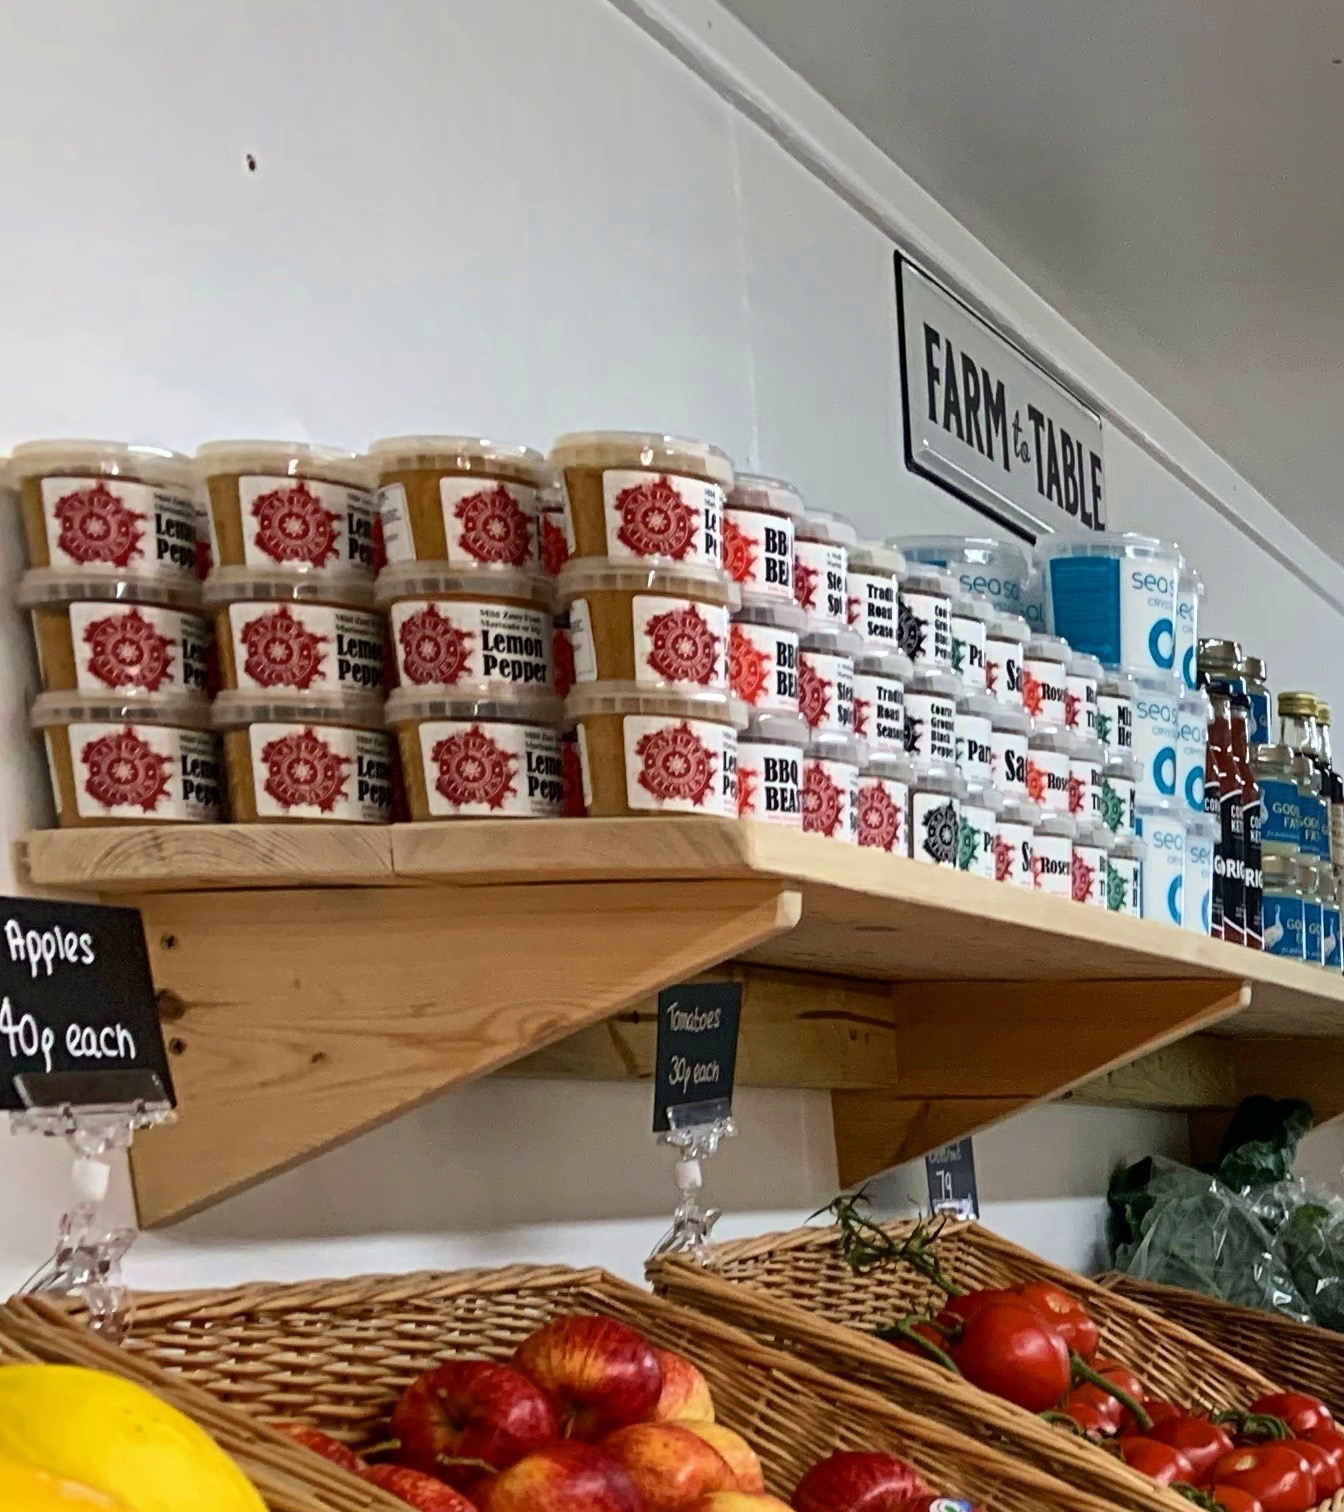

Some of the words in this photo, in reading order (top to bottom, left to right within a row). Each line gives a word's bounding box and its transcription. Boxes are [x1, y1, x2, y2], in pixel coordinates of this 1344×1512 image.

[922, 321, 1011, 474] FARM
[1013, 410, 1032, 464] to
[1028, 403, 1106, 532] TABLE
[482, 629, 543, 658] Lemon
[483, 654, 547, 683] Pepper
[4, 918, 96, 979] Apples
[0, 996, 56, 1074] 40p
[66, 1022, 136, 1061] each
[667, 1002, 722, 1033] Tomatoes
[668, 1055, 691, 1095] 30p
[693, 1061, 720, 1085] each
